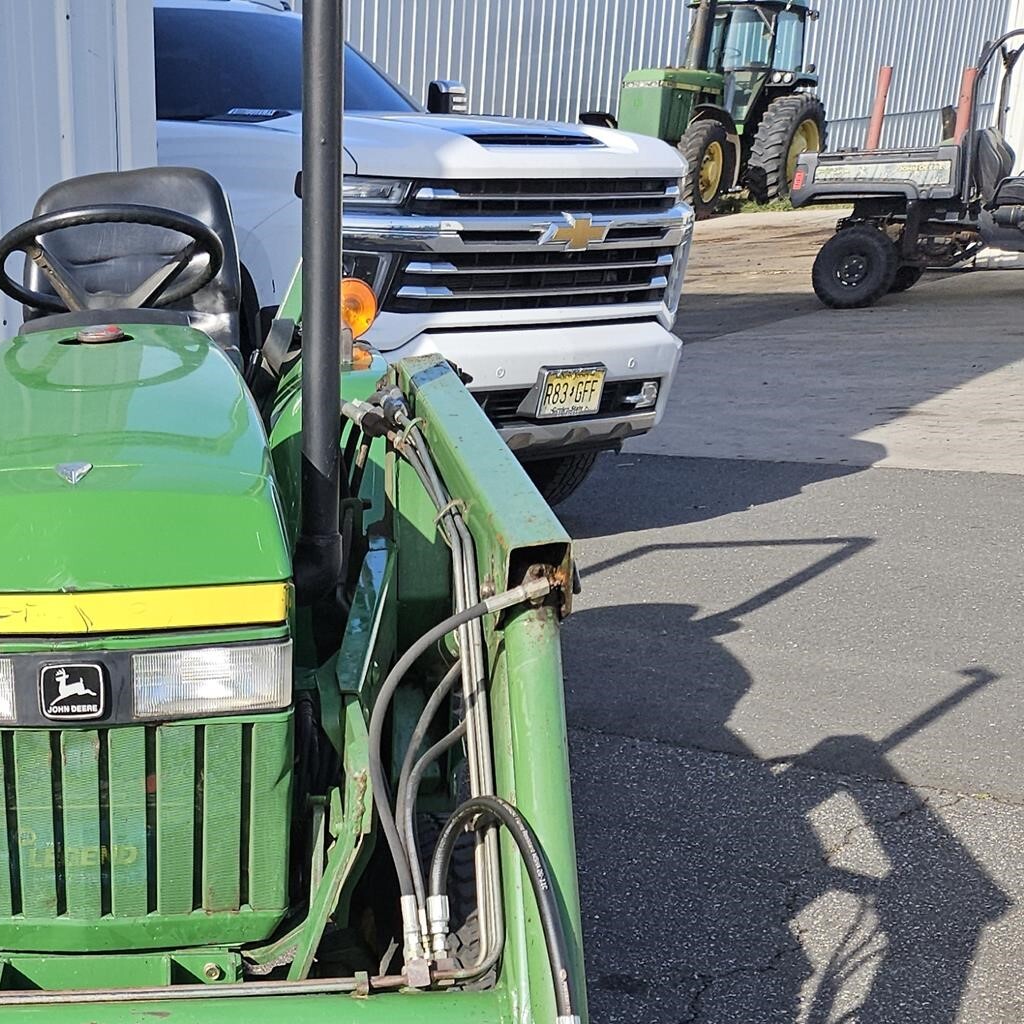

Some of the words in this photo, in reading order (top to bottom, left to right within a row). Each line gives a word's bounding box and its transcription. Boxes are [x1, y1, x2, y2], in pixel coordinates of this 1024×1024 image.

[543, 383, 568, 405] R83
[574, 380, 598, 402] GFF
[47, 705, 70, 714] JOHN
[70, 704, 98, 713] DEERE
